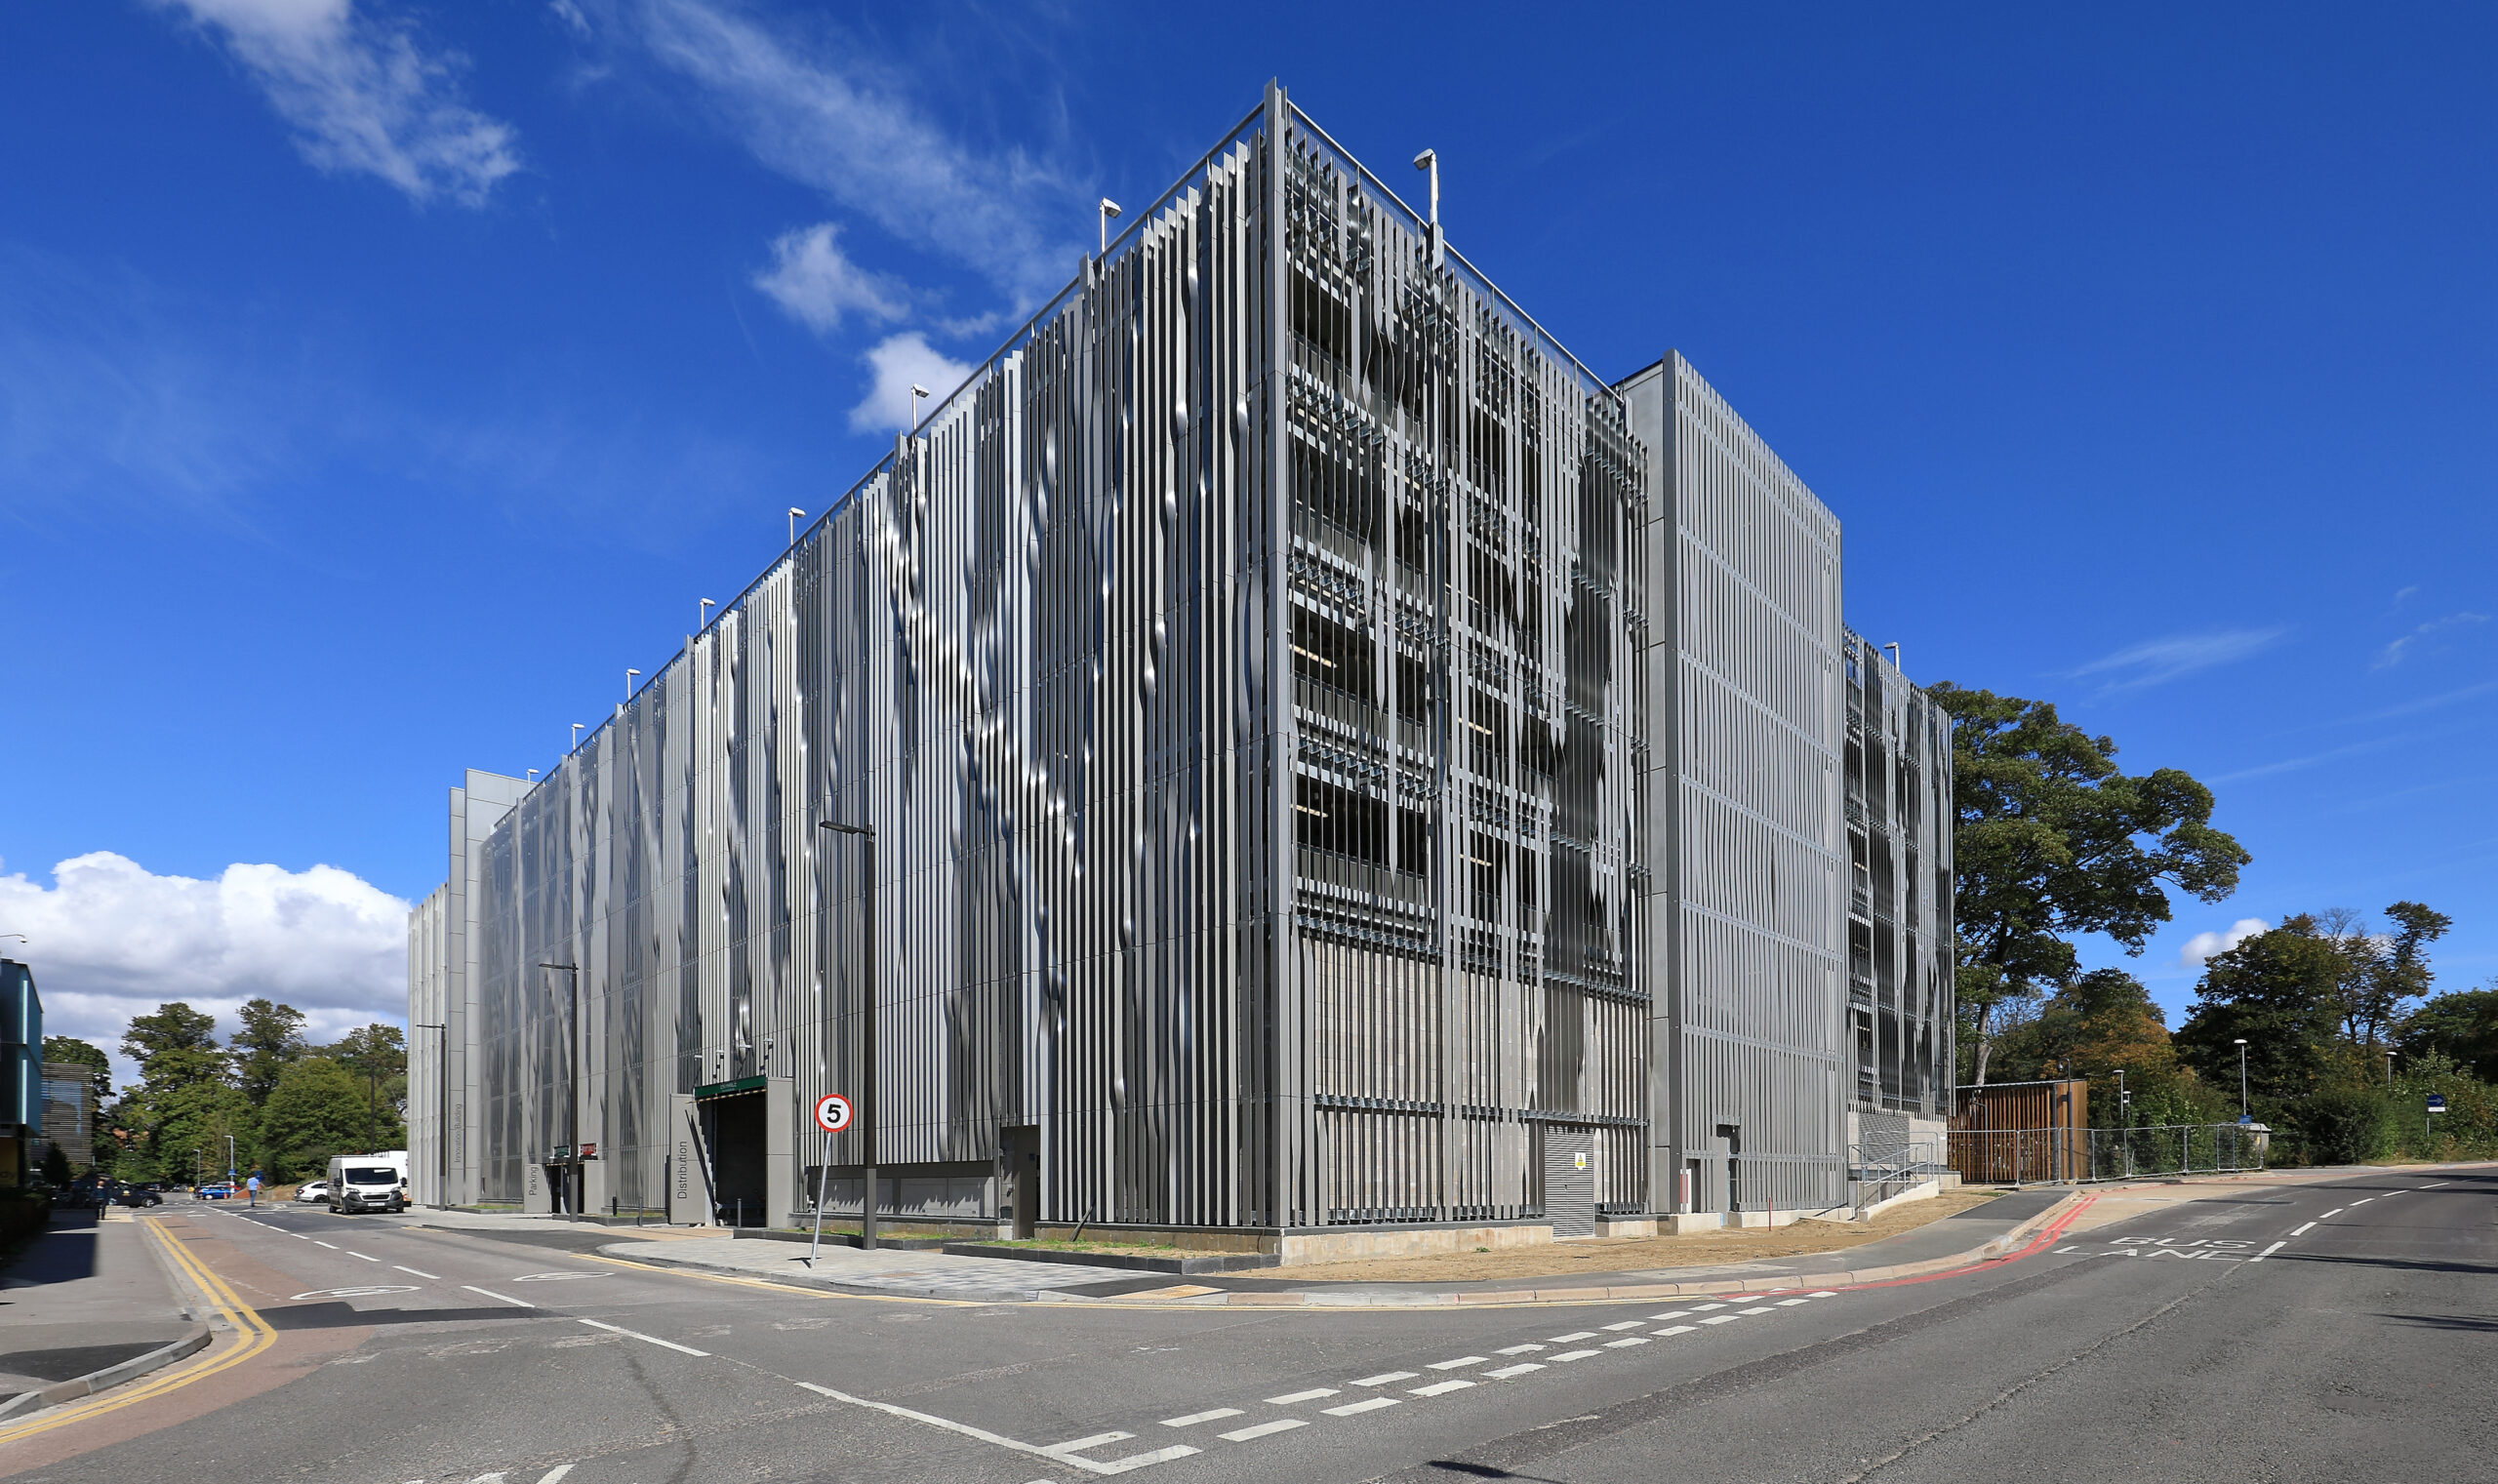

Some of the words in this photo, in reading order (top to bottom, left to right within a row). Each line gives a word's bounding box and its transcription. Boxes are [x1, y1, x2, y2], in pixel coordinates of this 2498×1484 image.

[453, 1103, 463, 1129] Building
[826, 1103, 841, 1123] 5
[453, 1131, 462, 1163] Innovation
[529, 1166, 540, 1196] Parking
[677, 1141, 687, 1199] Distribution
[2052, 1245, 2249, 1262] LANE
[2109, 1236, 2256, 1249] BUS
